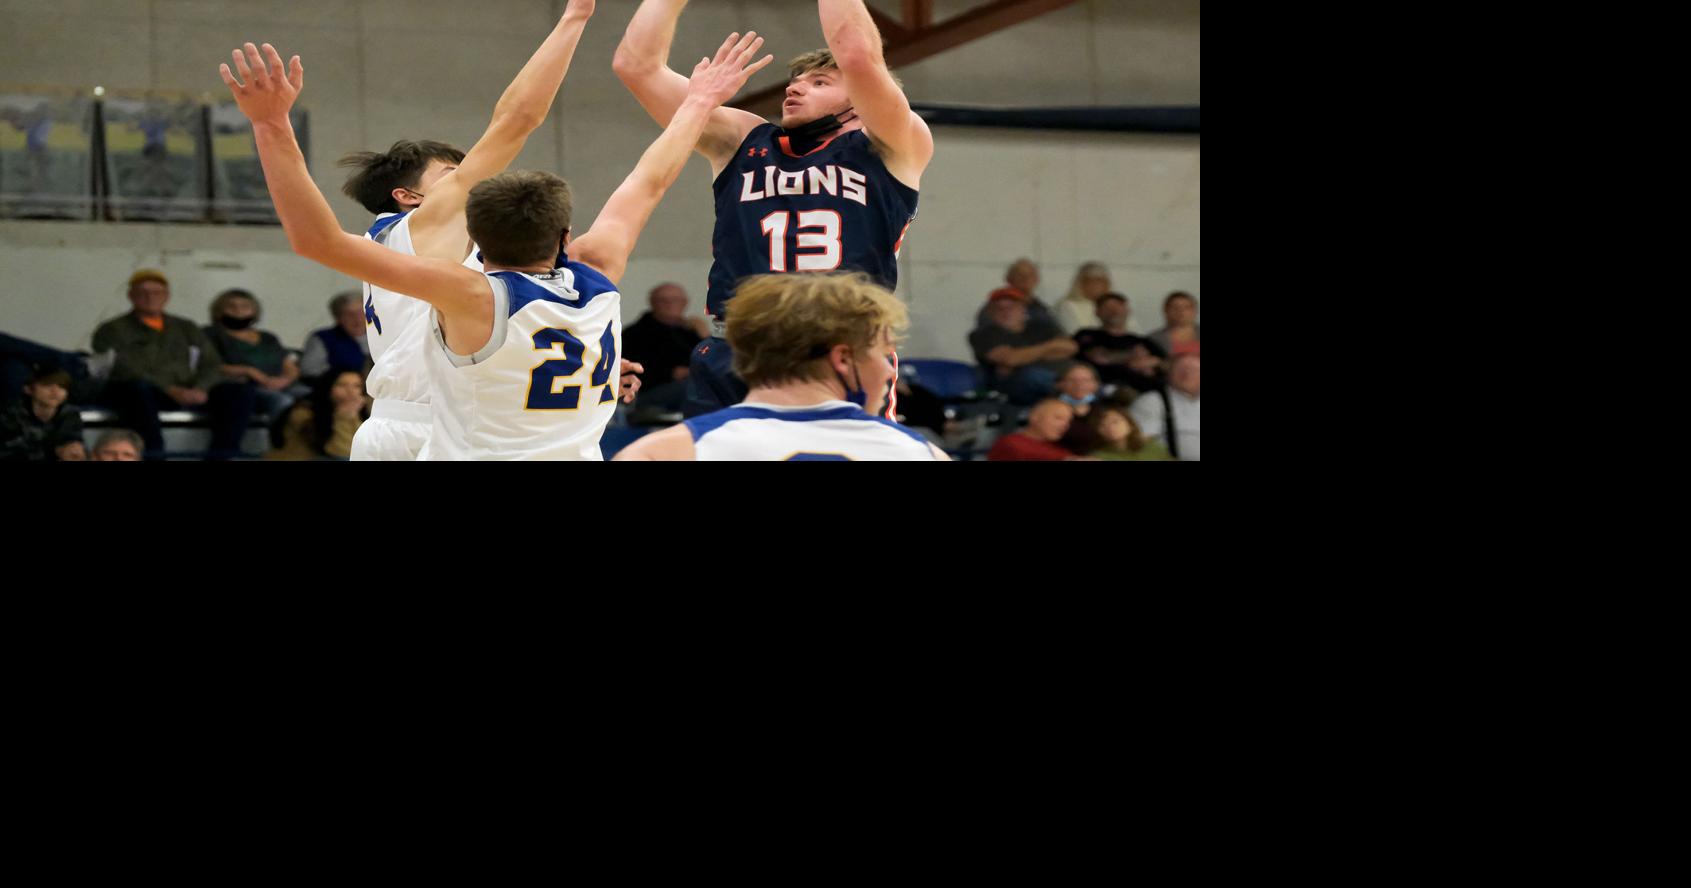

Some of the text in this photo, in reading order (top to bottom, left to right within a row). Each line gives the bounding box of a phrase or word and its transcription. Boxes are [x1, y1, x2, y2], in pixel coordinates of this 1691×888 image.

[740, 165, 867, 206] LIONS
[760, 208, 842, 272] 13
[524, 319, 616, 412] 24
